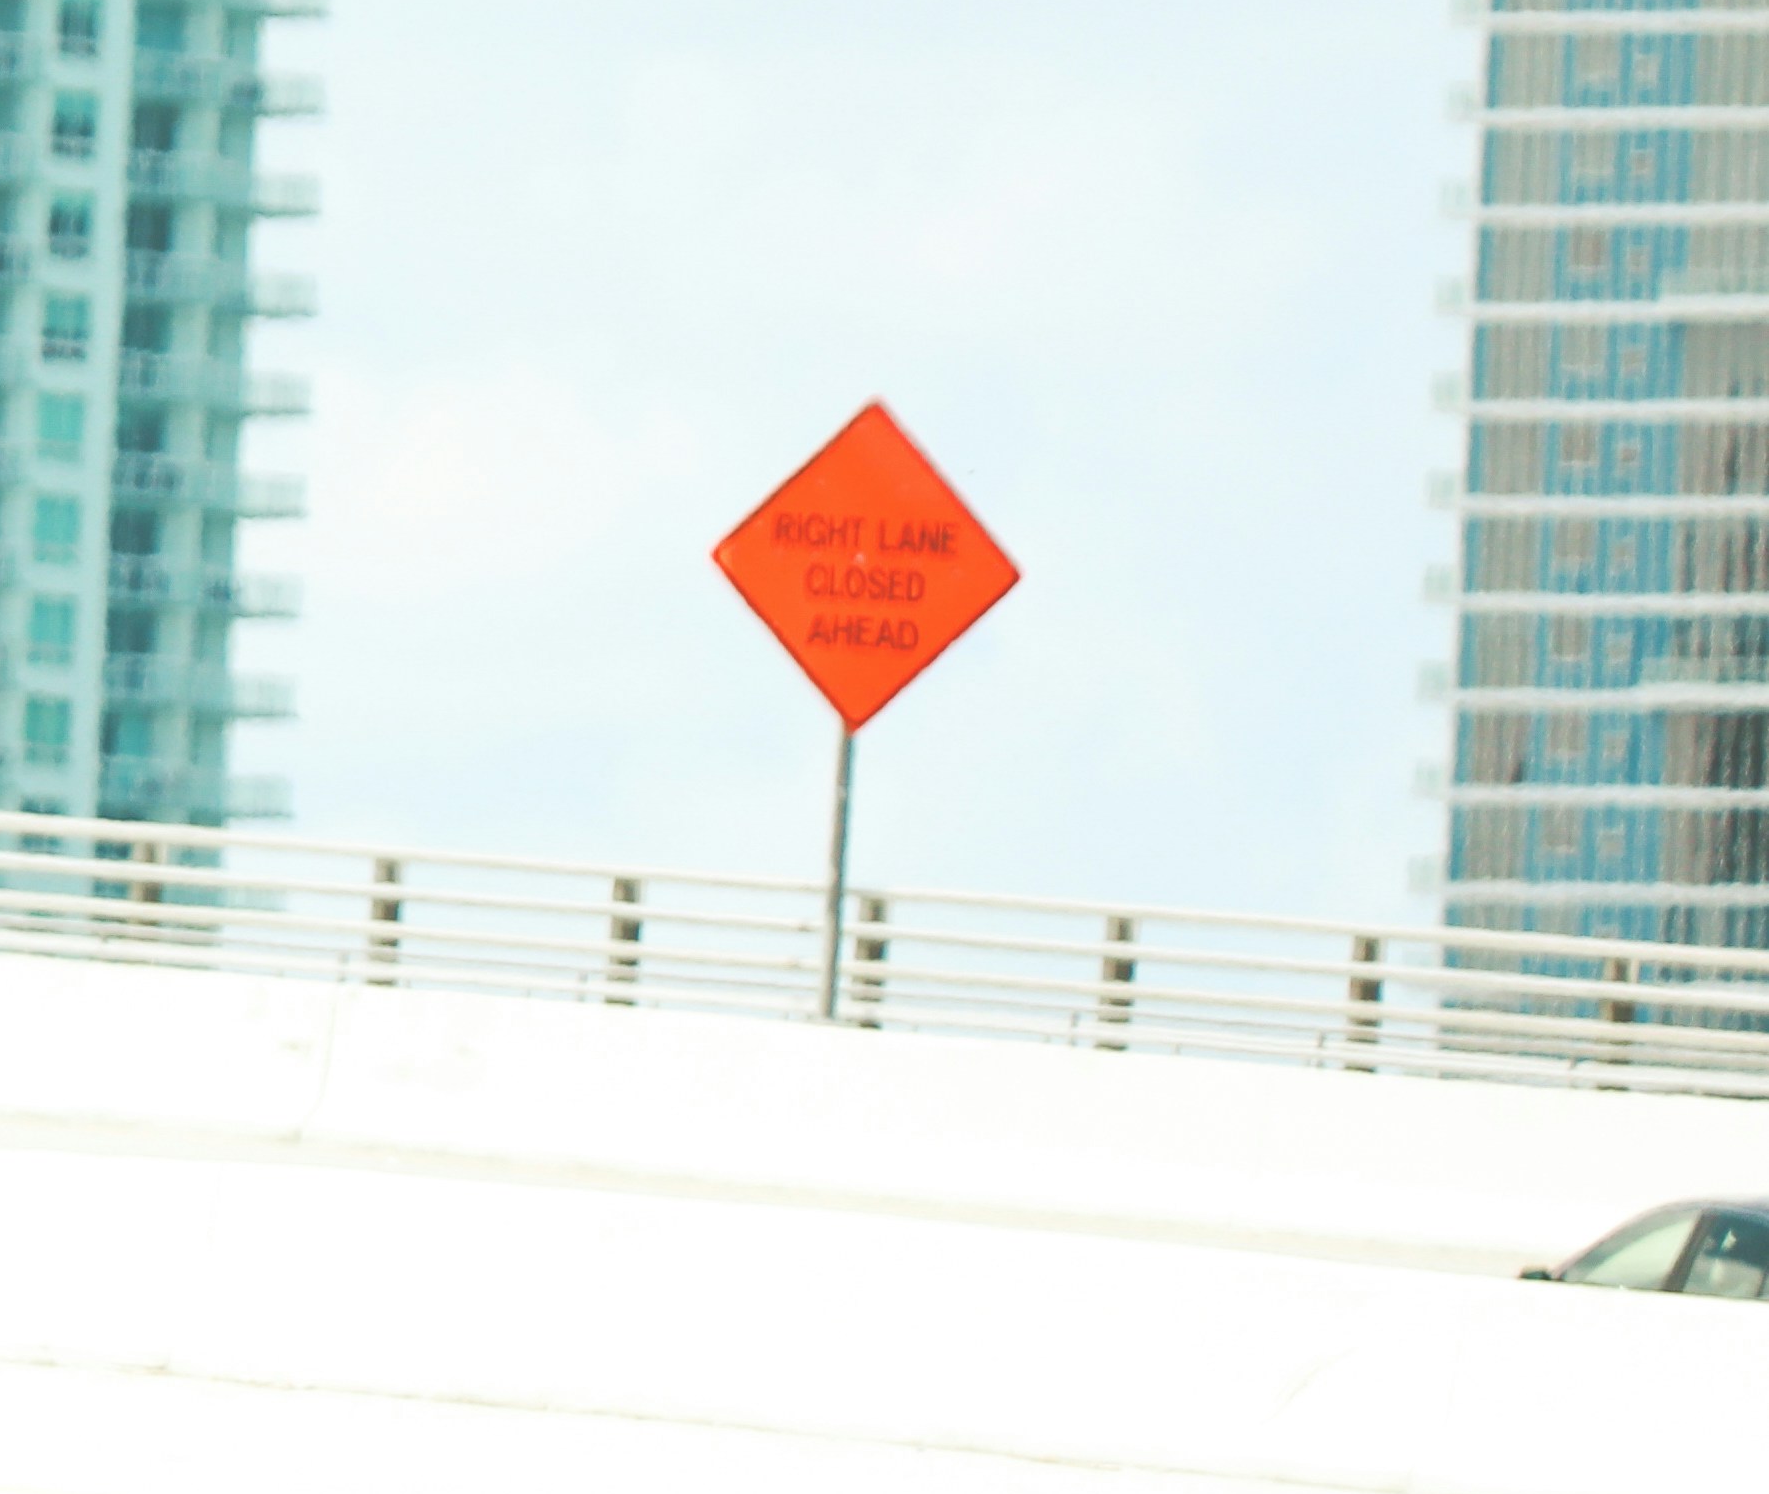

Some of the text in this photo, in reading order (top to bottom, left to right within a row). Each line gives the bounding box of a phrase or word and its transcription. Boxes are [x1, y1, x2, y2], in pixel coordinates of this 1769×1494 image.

[773, 511, 959, 557] RIGHT LANE
[804, 562, 926, 603] CLOSED
[805, 613, 920, 652] AHEAD
